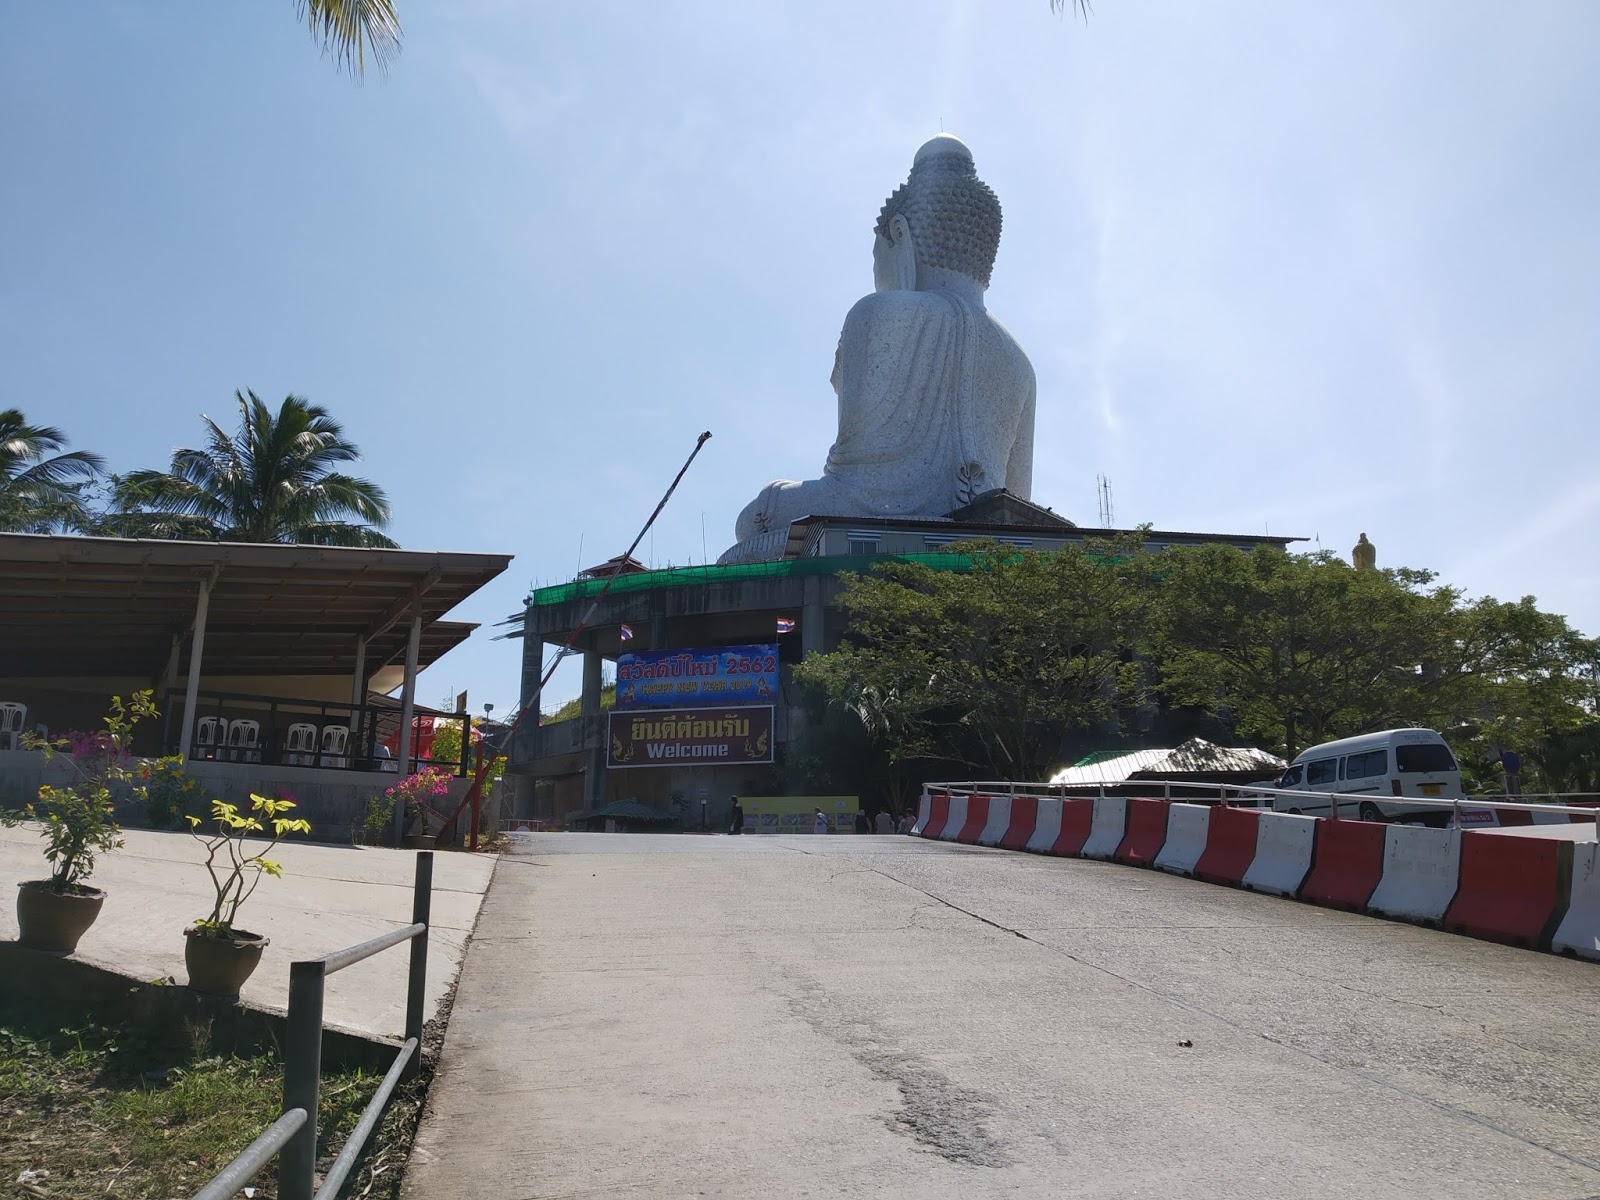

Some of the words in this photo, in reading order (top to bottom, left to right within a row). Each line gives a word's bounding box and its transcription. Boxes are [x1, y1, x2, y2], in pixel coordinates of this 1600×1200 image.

[619, 653, 718, 680] สวัสดีปีใหม่
[726, 656, 777, 675] 2562
[642, 683, 674, 695] HAPPY
[677, 682, 698, 693] NEW
[701, 681, 727, 692] YEAR
[730, 679, 752, 691] 2019
[631, 713, 750, 741] ยินดีต้อนรับ
[646, 742, 729, 759] Welcome
